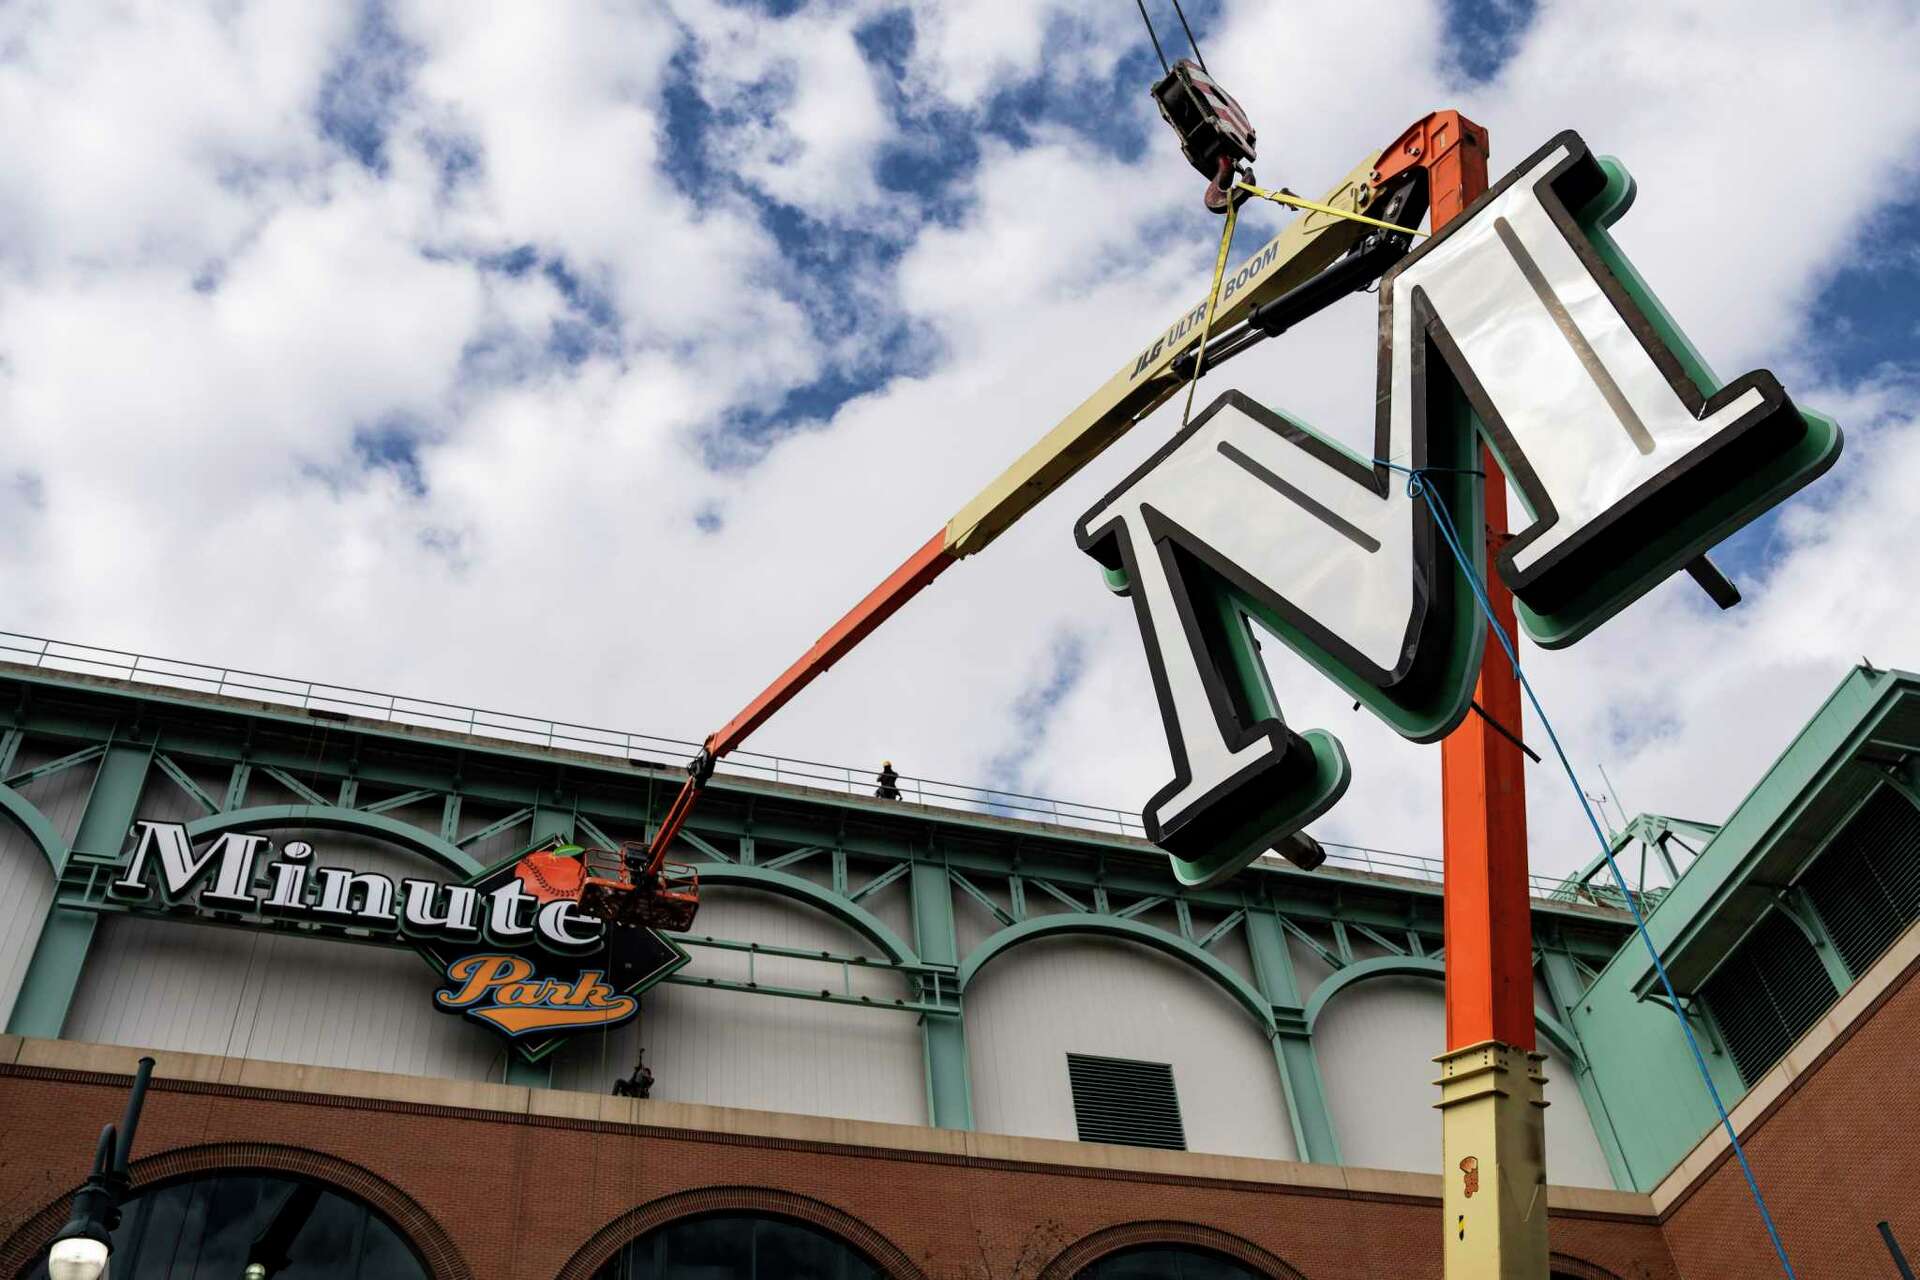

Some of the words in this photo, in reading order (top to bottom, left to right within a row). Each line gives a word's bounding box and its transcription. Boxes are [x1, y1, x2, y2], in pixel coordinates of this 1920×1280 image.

[1130, 337, 1165, 381] JLG
[1167, 300, 1219, 347] ULTR
[1223, 240, 1279, 301] BOOM
[1074, 129, 1798, 850] M
[114, 820, 602, 945] Minute
[436, 953, 636, 1012] Park
